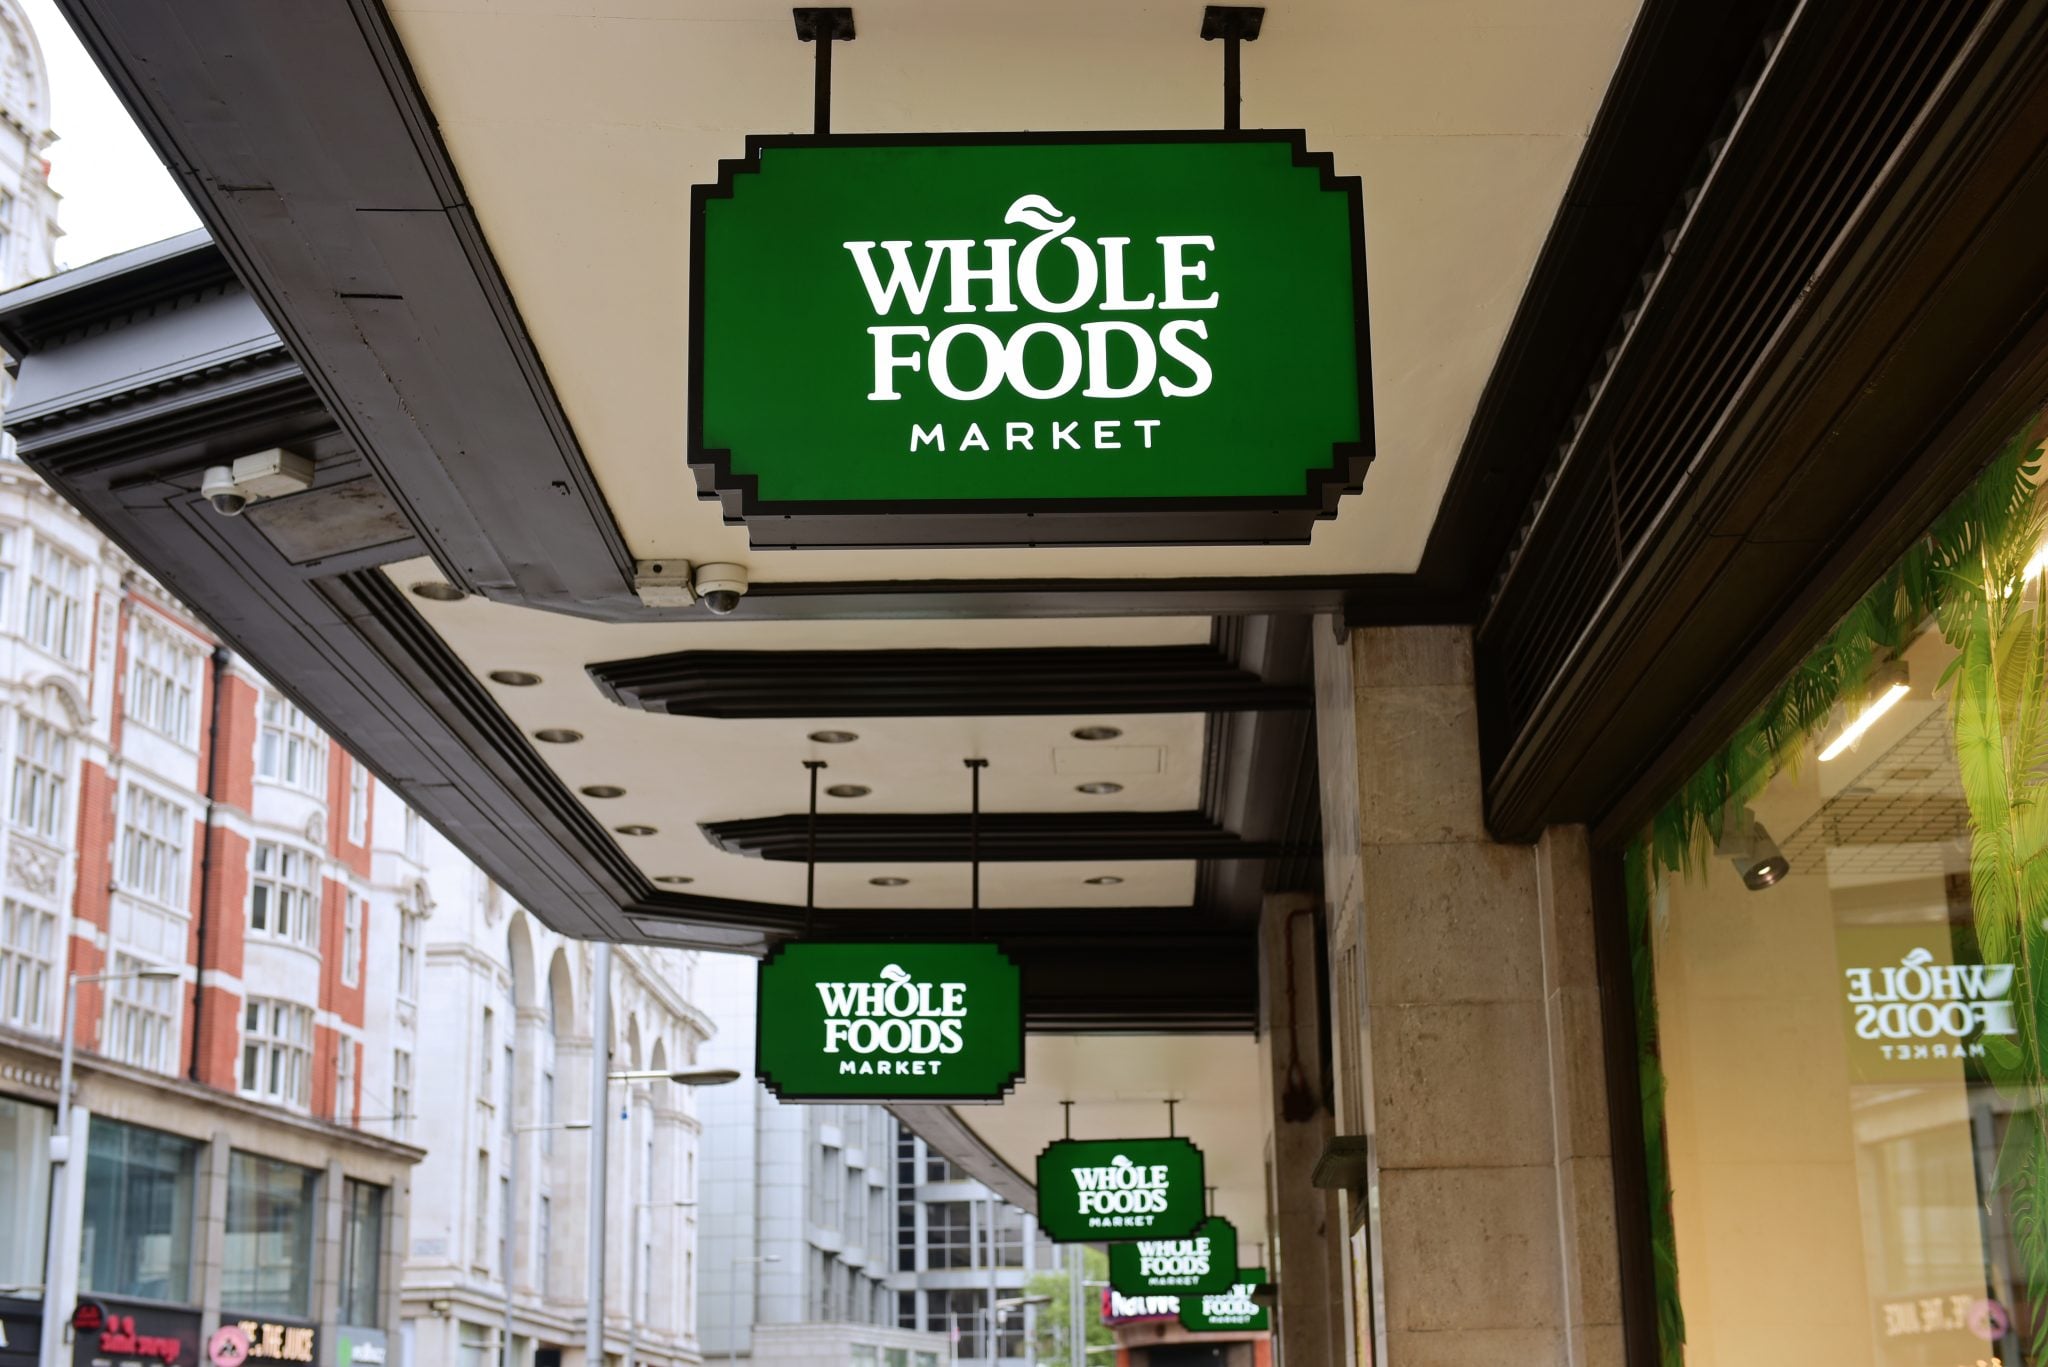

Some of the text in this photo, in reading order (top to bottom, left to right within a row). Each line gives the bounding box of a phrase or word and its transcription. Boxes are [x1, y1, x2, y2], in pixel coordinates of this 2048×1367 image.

[842, 230, 1220, 316] WHOLE
[866, 319, 1213, 401] FOODS
[909, 419, 1161, 453] MARKET
[815, 981, 968, 1018] WHOLE
[823, 1018, 964, 1055] FOODS
[839, 1060, 942, 1075] MARKET
[1071, 1165, 1170, 1191] WHOLE
[1078, 1188, 1168, 1214] FOODS
[1089, 1215, 1155, 1227] MARKET
[1136, 1237, 1212, 1258] WHOLE
[1140, 1255, 1211, 1276] FOODS
